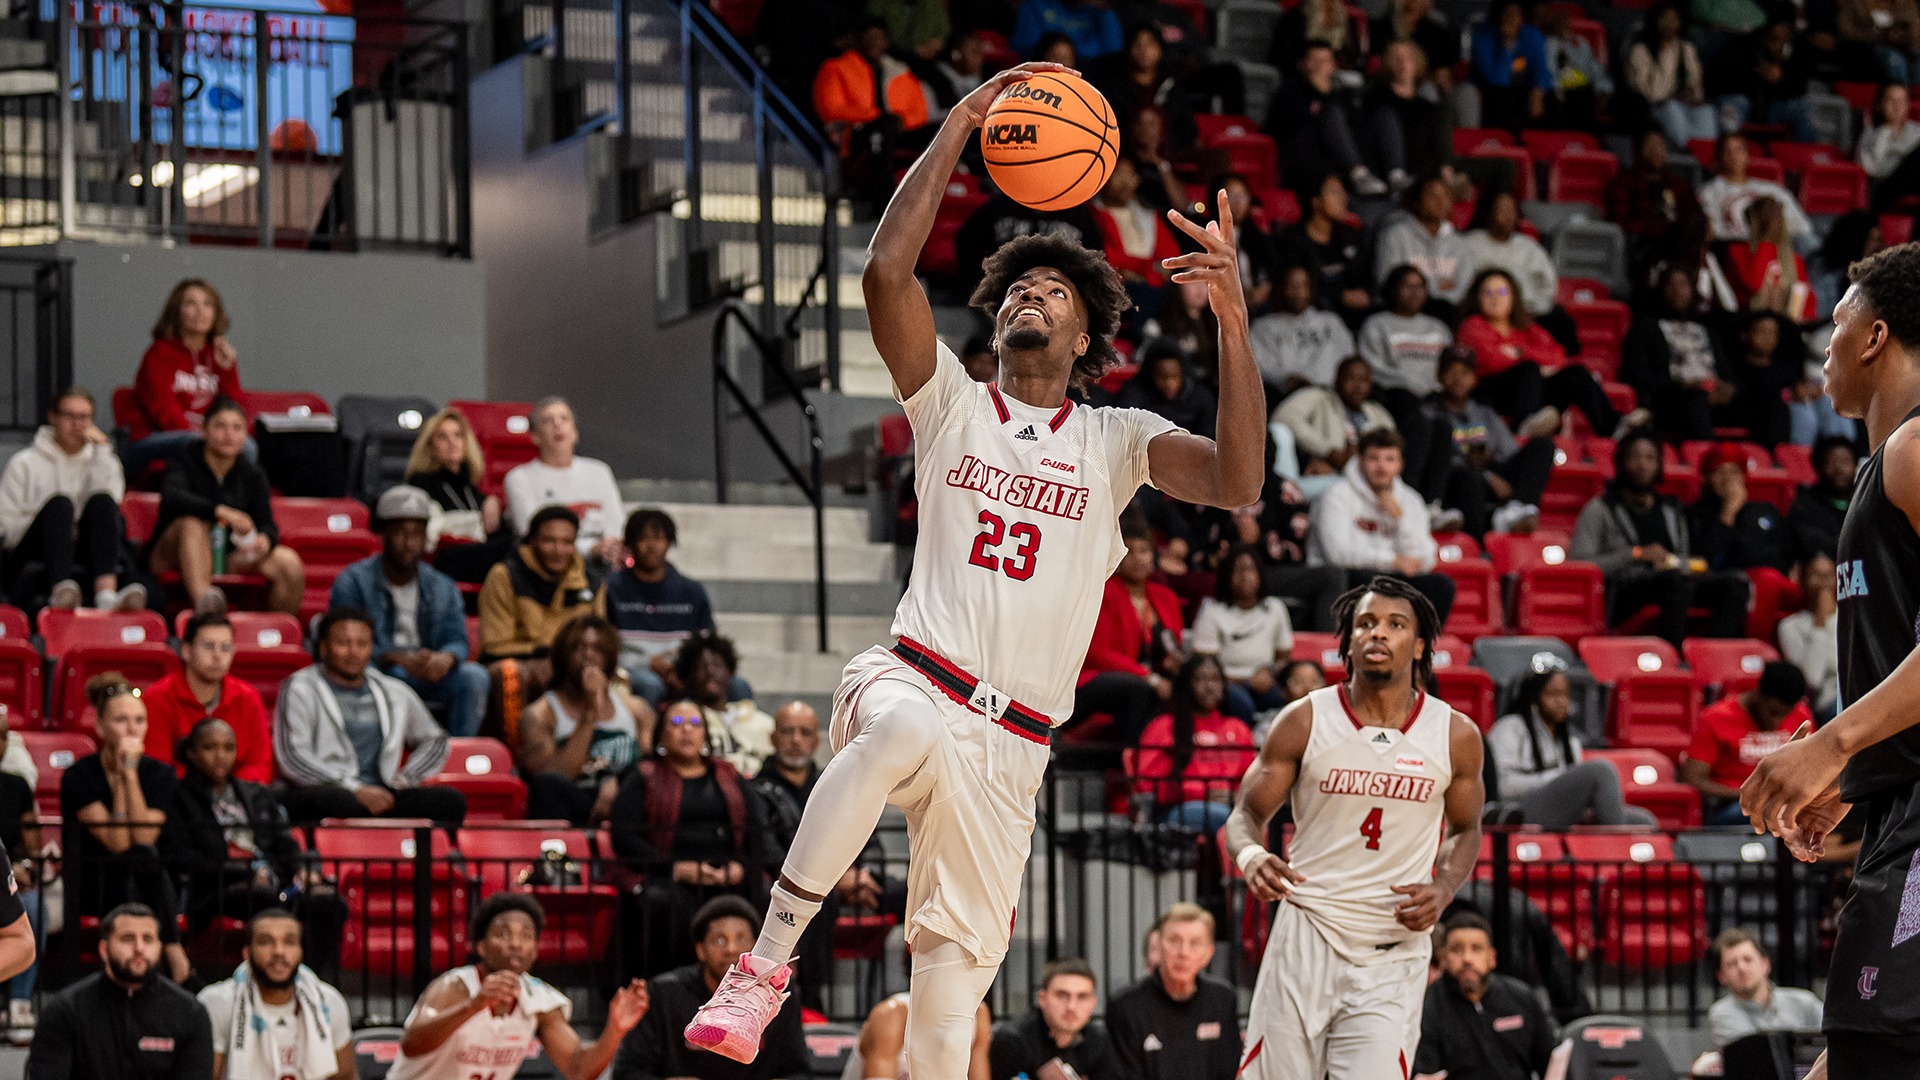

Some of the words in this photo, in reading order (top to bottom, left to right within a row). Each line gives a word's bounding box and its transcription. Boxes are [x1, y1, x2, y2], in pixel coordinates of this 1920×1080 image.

[995, 81, 1063, 110] ilson
[986, 123, 1038, 146] NCAA
[1014, 433, 1038, 442] adidas
[946, 454, 1011, 501] JAX
[1004, 474, 1090, 521] STATE
[968, 508, 1042, 582] 23
[1319, 768, 1371, 796] JAX
[1369, 772, 1435, 803] STATE
[1359, 806, 1383, 851] 4
